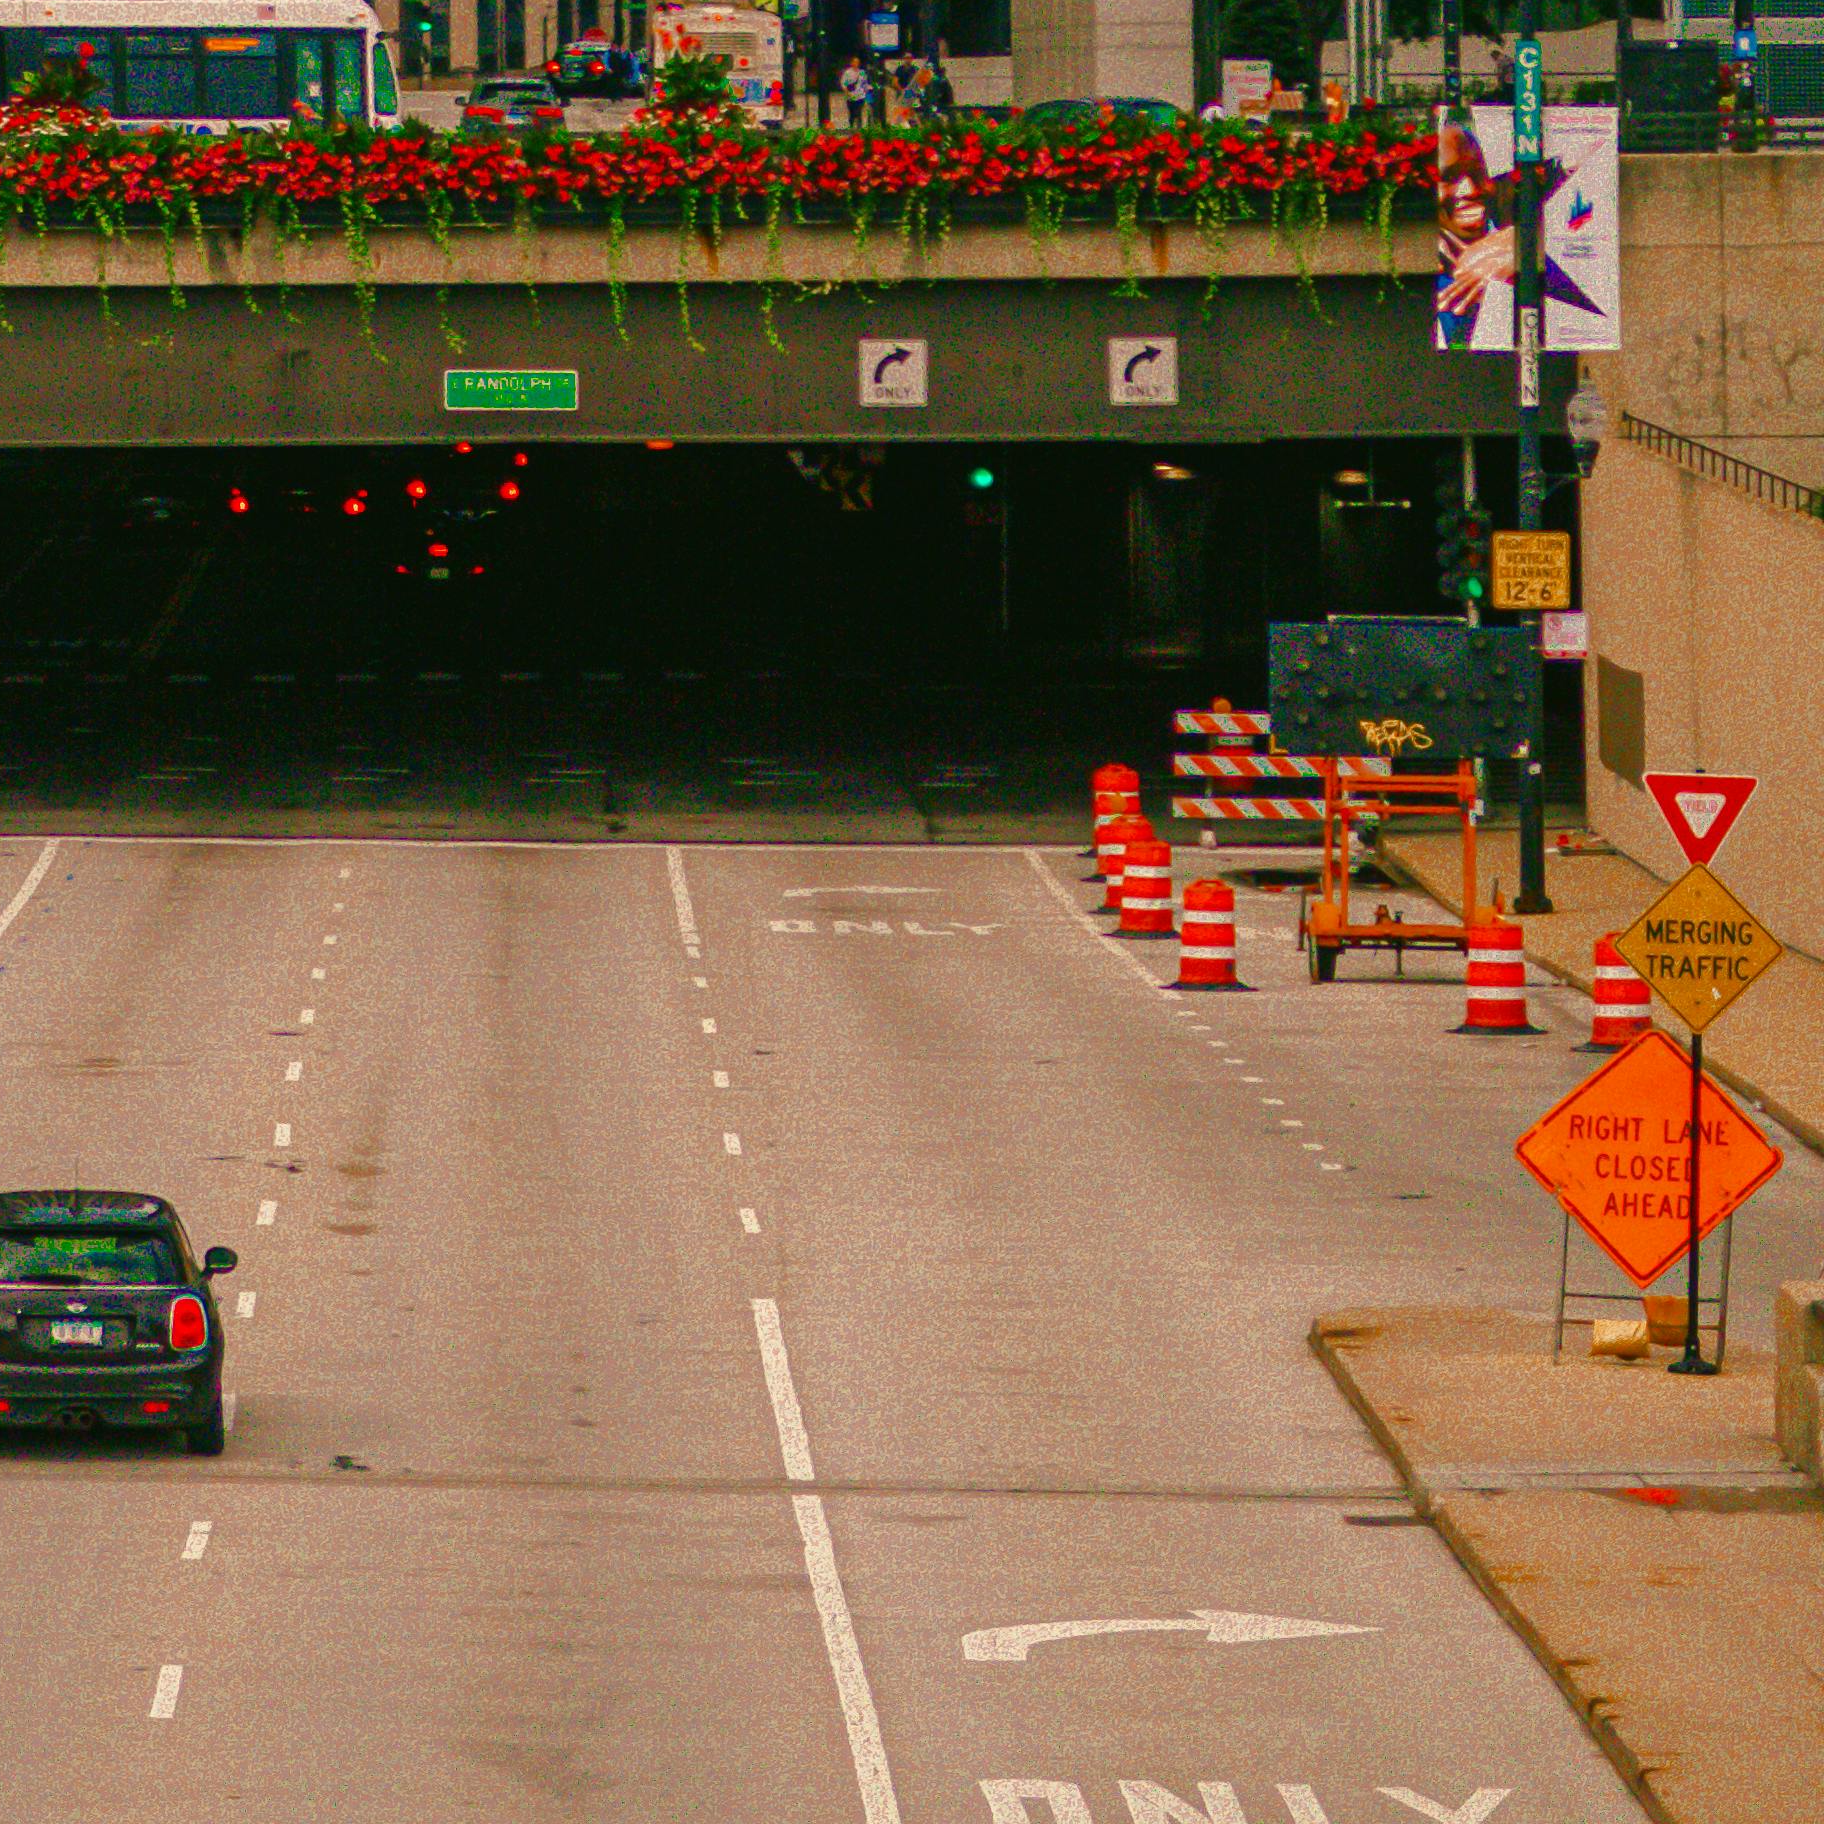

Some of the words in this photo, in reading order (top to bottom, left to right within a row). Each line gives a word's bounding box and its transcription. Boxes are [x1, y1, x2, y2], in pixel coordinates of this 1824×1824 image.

[464, 377, 551, 390] RANDOLPH
[1125, 385, 1163, 398] ONLY
[875, 387, 912, 399] ONLY
[1683, 799, 1719, 814] YIELD
[769, 919, 1006, 936] ONLY
[1645, 919, 1753, 945] MERGING
[1645, 954, 1750, 982] TRAFFIC
[1569, 1114, 1644, 1142] RIGHT
[1663, 1118, 1729, 1146] LANE
[1603, 1191, 1692, 1219] AHEAD
